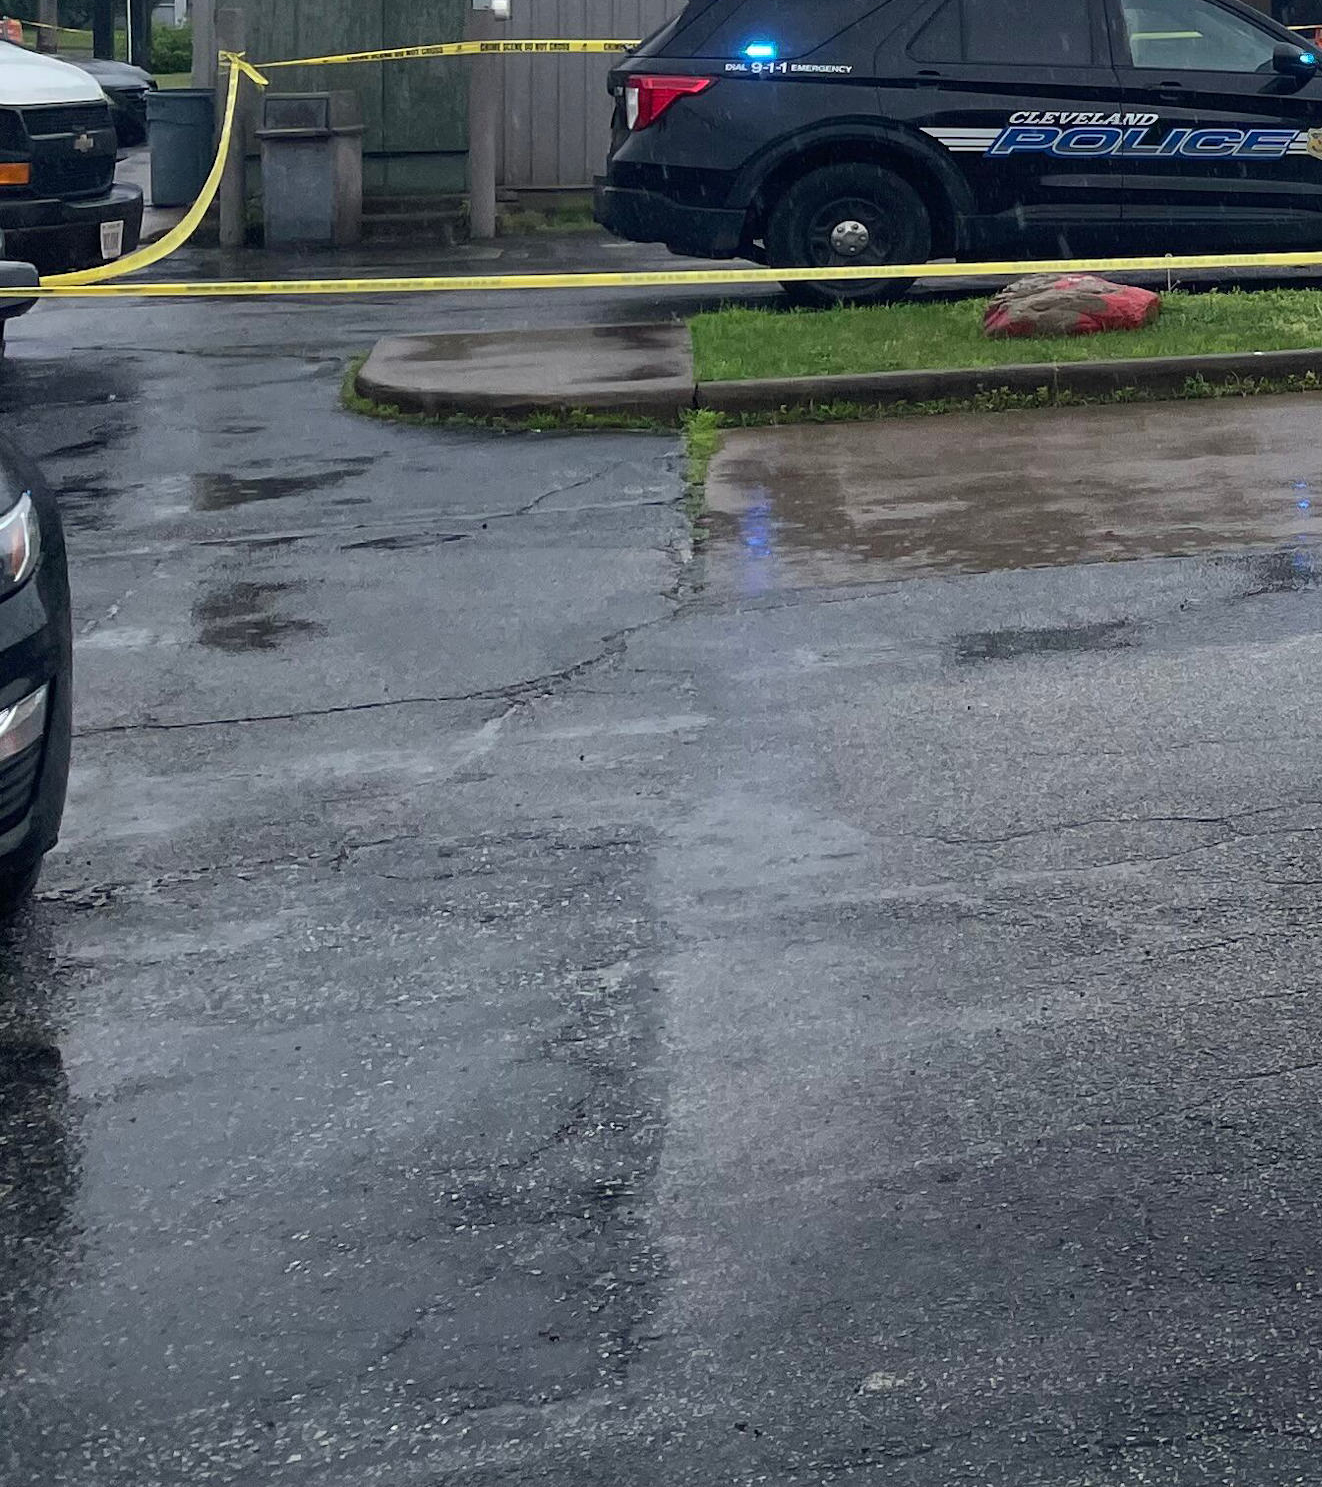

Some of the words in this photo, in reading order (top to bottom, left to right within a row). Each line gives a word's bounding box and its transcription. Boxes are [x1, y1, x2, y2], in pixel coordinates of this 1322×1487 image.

[725, 63, 748, 71] DIAL
[751, 62, 788, 73] 9-1-1
[790, 64, 853, 73] EMERGENCY
[1008, 111, 1160, 126] CLEVELAND
[988, 126, 1299, 159] POLICE
